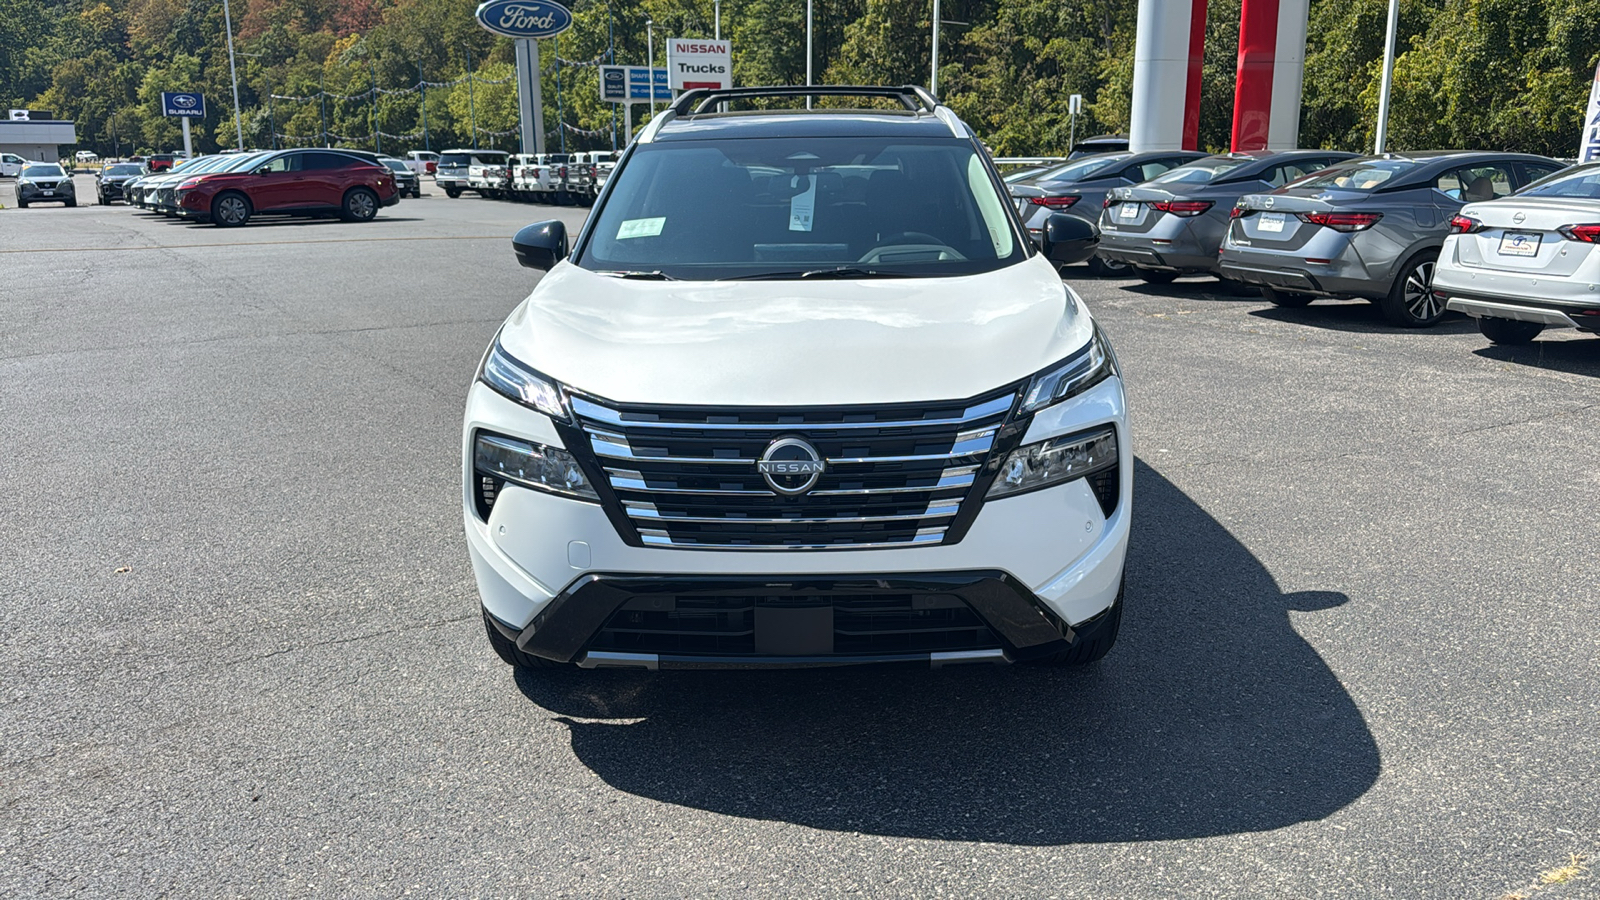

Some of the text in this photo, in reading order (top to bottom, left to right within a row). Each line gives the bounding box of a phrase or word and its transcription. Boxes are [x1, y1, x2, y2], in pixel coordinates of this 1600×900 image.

[500, 4, 555, 29] Ford
[676, 43, 726, 54] NISSAN
[678, 63, 726, 74] Trucks
[759, 462, 823, 472] NISSAN
